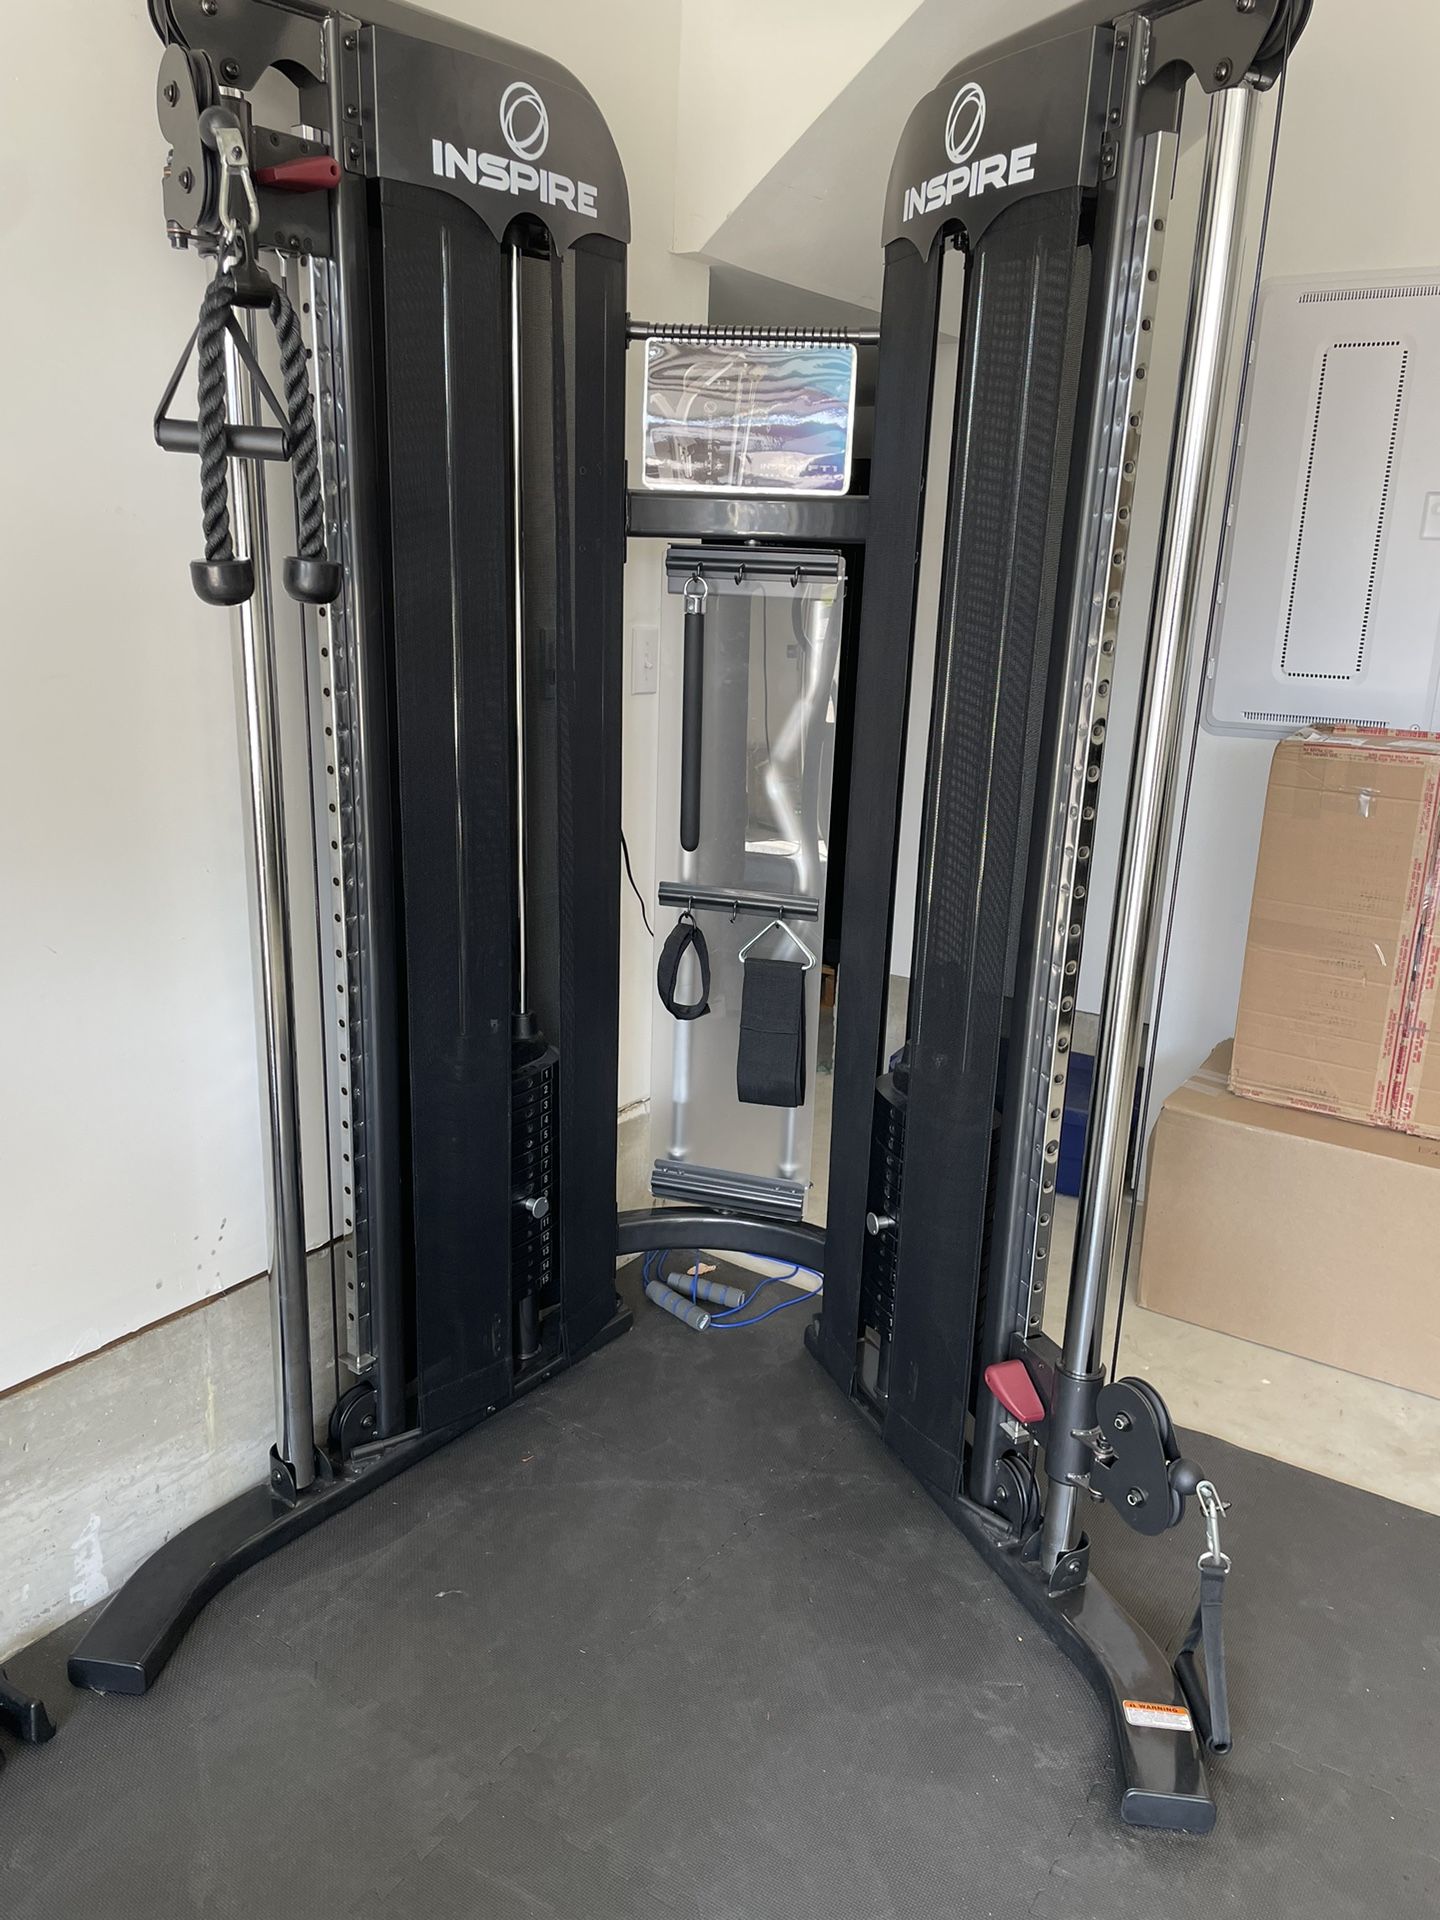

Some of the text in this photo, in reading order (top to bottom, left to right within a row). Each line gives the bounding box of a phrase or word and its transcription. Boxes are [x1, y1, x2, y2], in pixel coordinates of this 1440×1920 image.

[432, 138, 598, 218] INSPIRE
[903, 142, 1037, 222] INSPIRE
[543, 1085, 549, 1095] 2
[543, 1100, 549, 1110] 3
[543, 1115, 549, 1124] 4
[543, 1129, 549, 1139] 5
[543, 1144, 549, 1154] 6
[543, 1159, 549, 1169] 7
[543, 1174, 549, 1184] 8
[543, 1216, 550, 1227] 11
[542, 1231, 550, 1242] 12
[1139, 1703, 1178, 1713] WARNING
